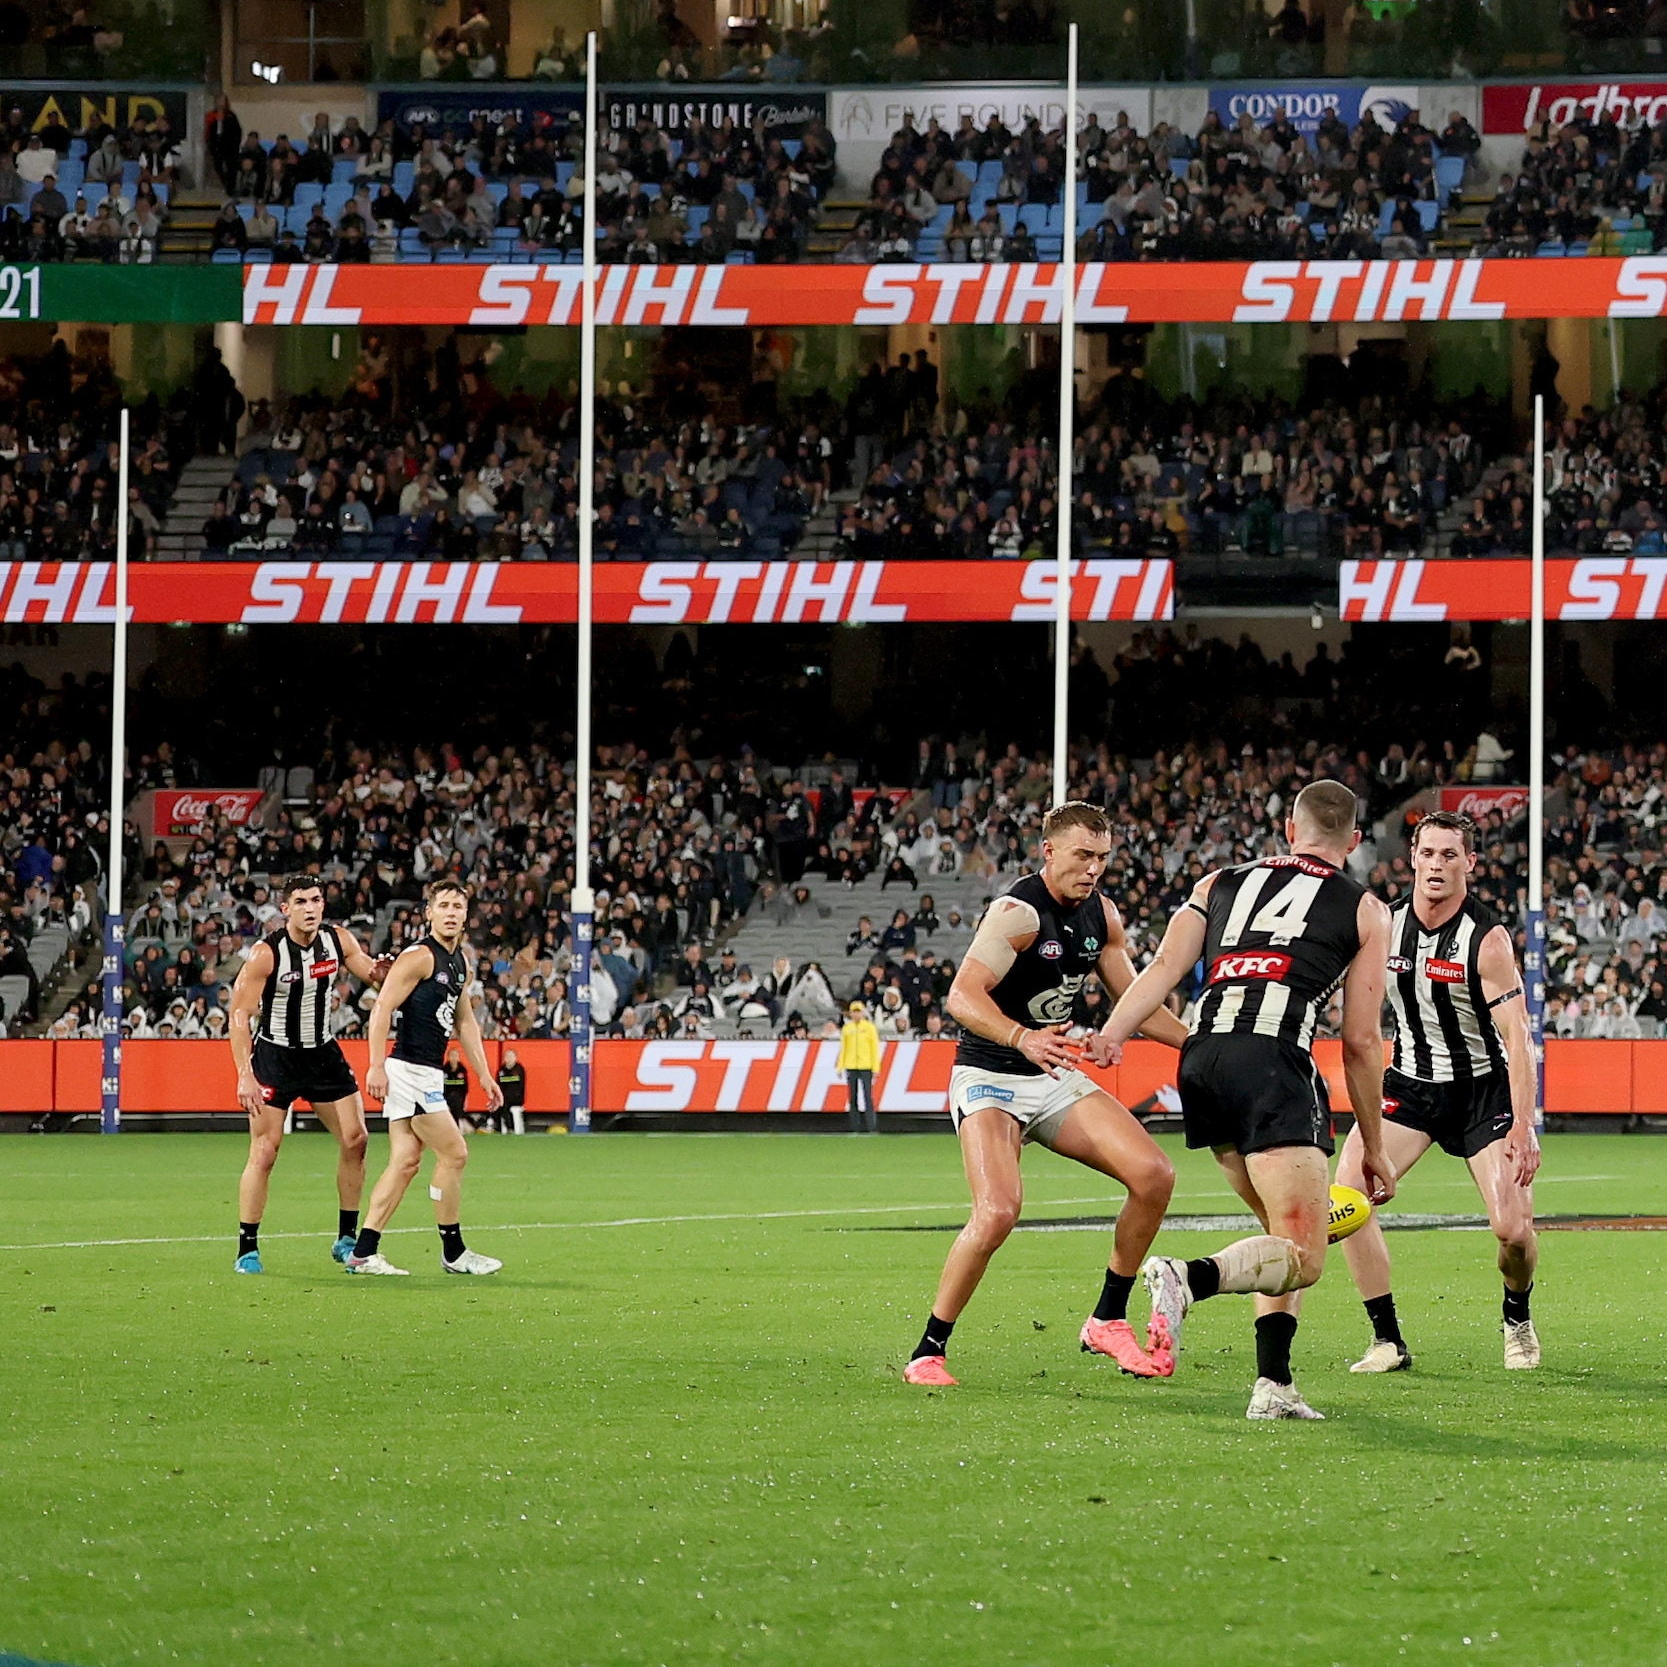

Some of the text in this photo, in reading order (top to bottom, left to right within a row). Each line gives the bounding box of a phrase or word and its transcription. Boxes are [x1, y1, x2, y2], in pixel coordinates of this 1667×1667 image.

[1229, 93, 1341, 118] CONDOR
[469, 264, 749, 325] STIHL
[854, 263, 1128, 324] STIHL
[1233, 259, 1505, 321] STIHL
[241, 563, 522, 622] STIHL
[628, 561, 907, 622] STIHL
[1220, 868, 1323, 947] 14
[1042, 944, 1063, 955] AFL
[1214, 957, 1283, 979] KFC
[1386, 958, 1411, 971] AFL
[1426, 963, 1464, 979] Emirates
[281, 970, 302, 983] AFL
[624, 1040, 949, 1112] STIHL
